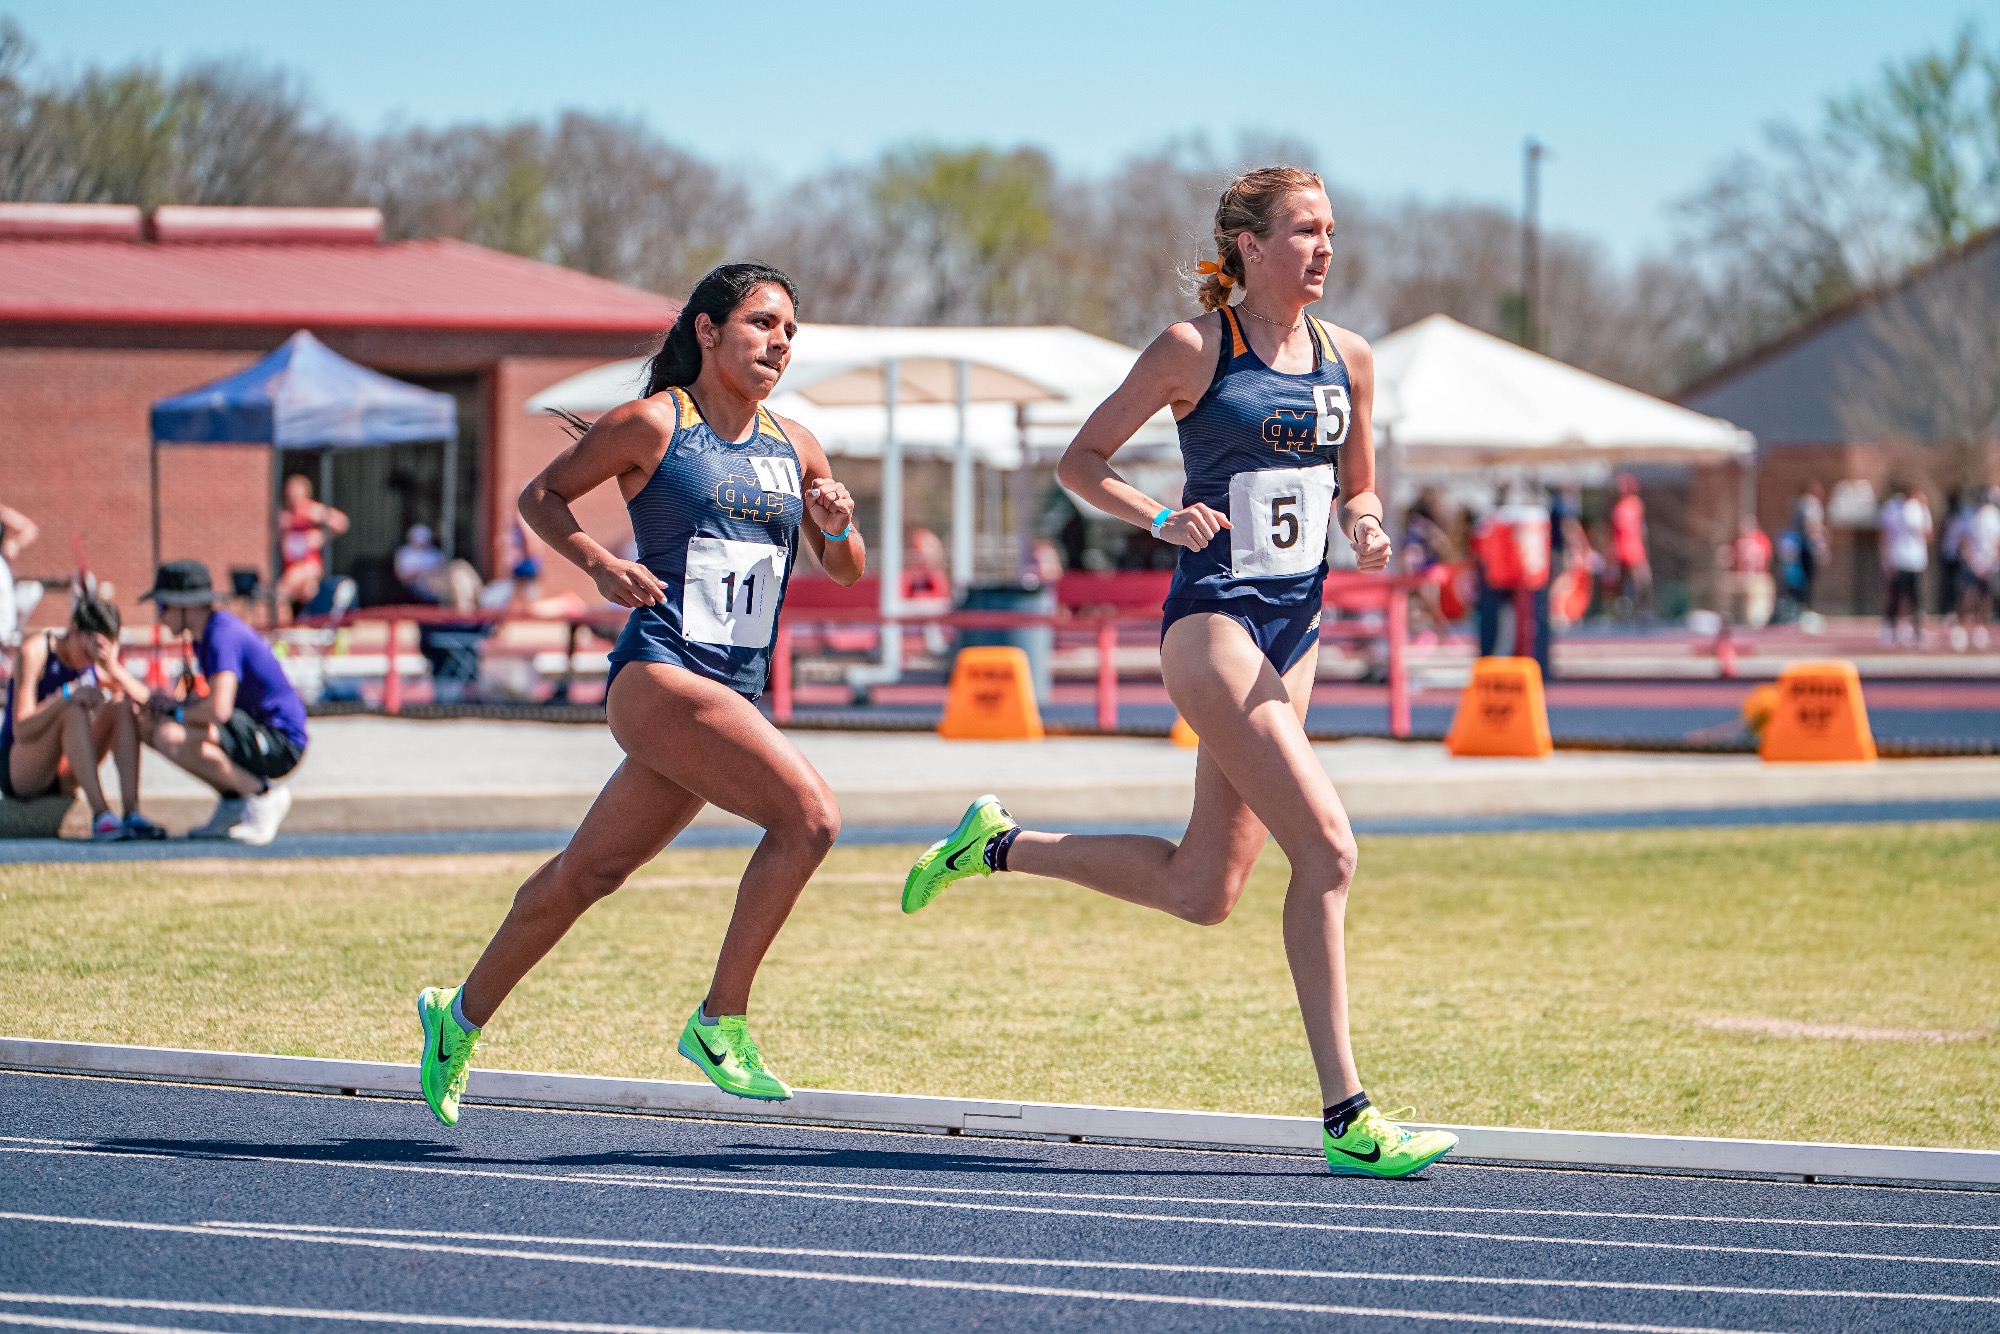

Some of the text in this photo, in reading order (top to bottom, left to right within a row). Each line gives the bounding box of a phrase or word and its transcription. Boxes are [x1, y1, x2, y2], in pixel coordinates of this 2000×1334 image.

[1323, 388, 1344, 442] 5
[760, 458, 795, 493] 11
[1271, 495, 1299, 549] 5
[721, 571, 756, 615] 11
